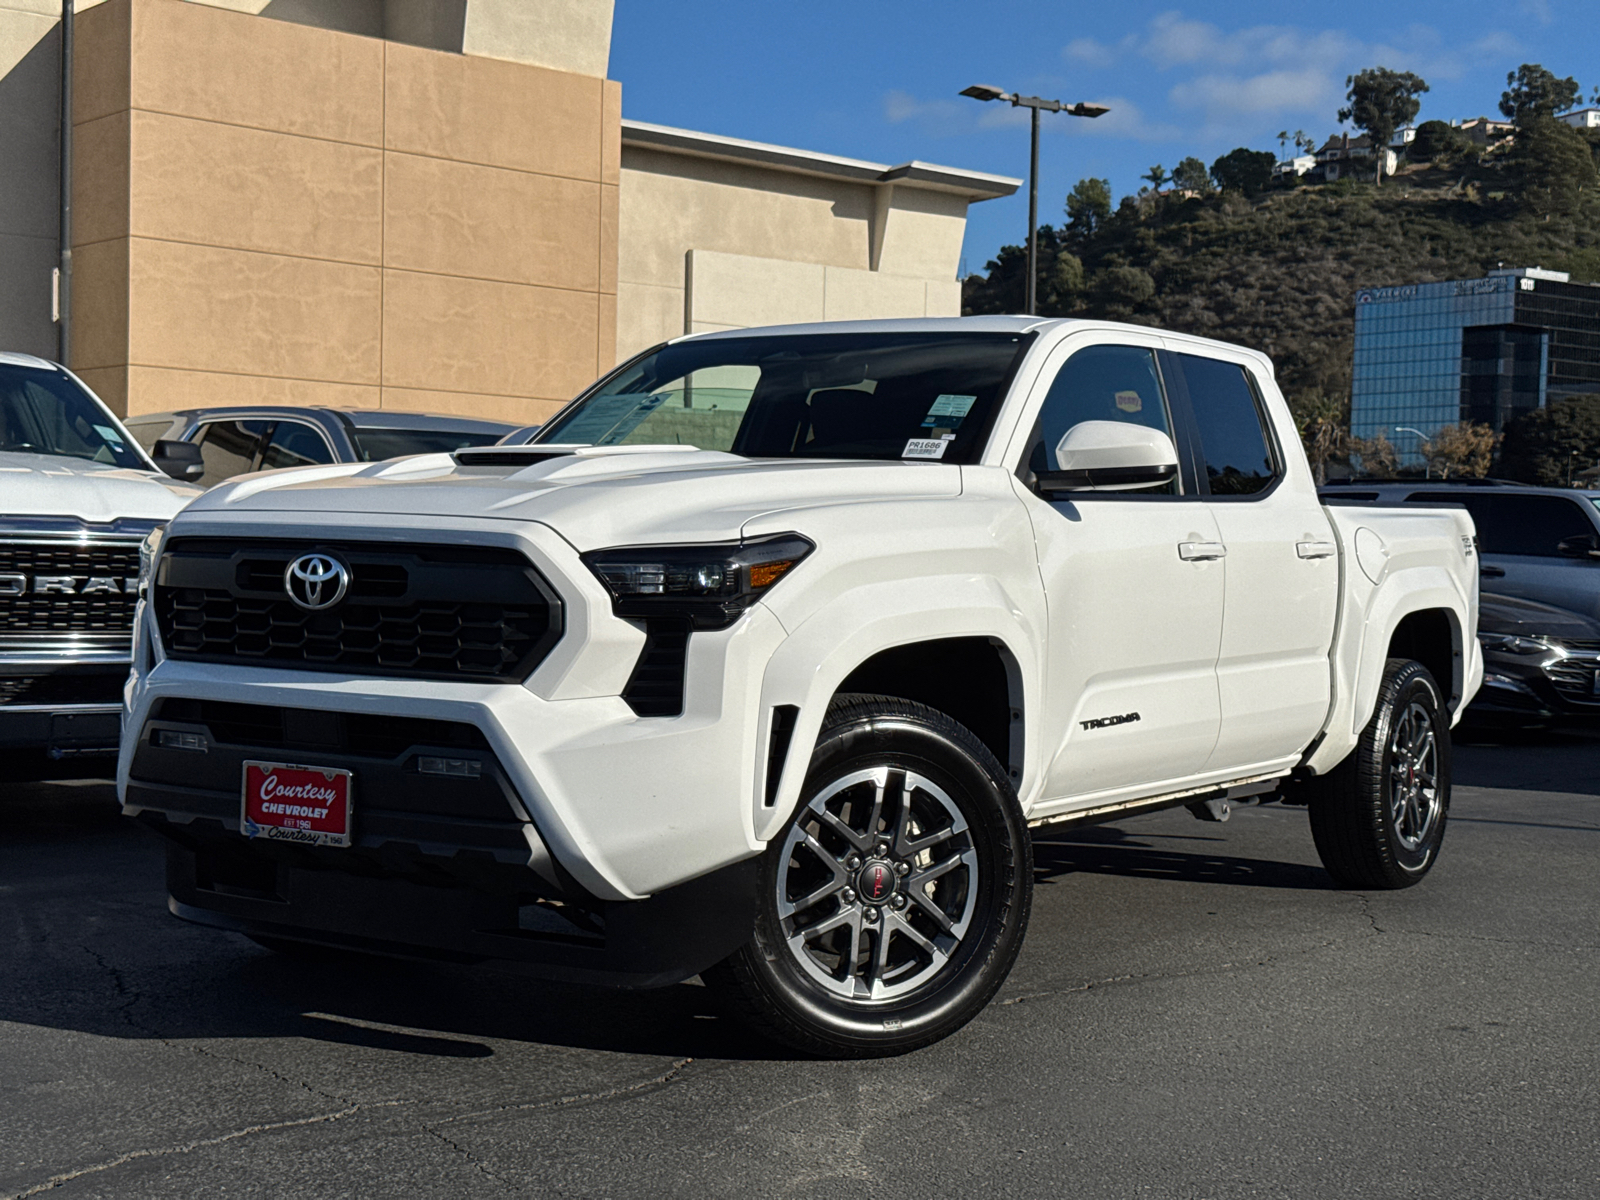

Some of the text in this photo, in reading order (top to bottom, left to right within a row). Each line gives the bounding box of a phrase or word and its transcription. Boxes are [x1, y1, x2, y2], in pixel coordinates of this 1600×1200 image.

[908, 441, 942, 449] PR1686
[1079, 711, 1142, 731] TACOMA
[260, 775, 337, 807] Courtesy
[261, 802, 329, 819] CHEVROLET
[296, 819, 312, 830] 1961
[268, 826, 321, 847] Courtesy
